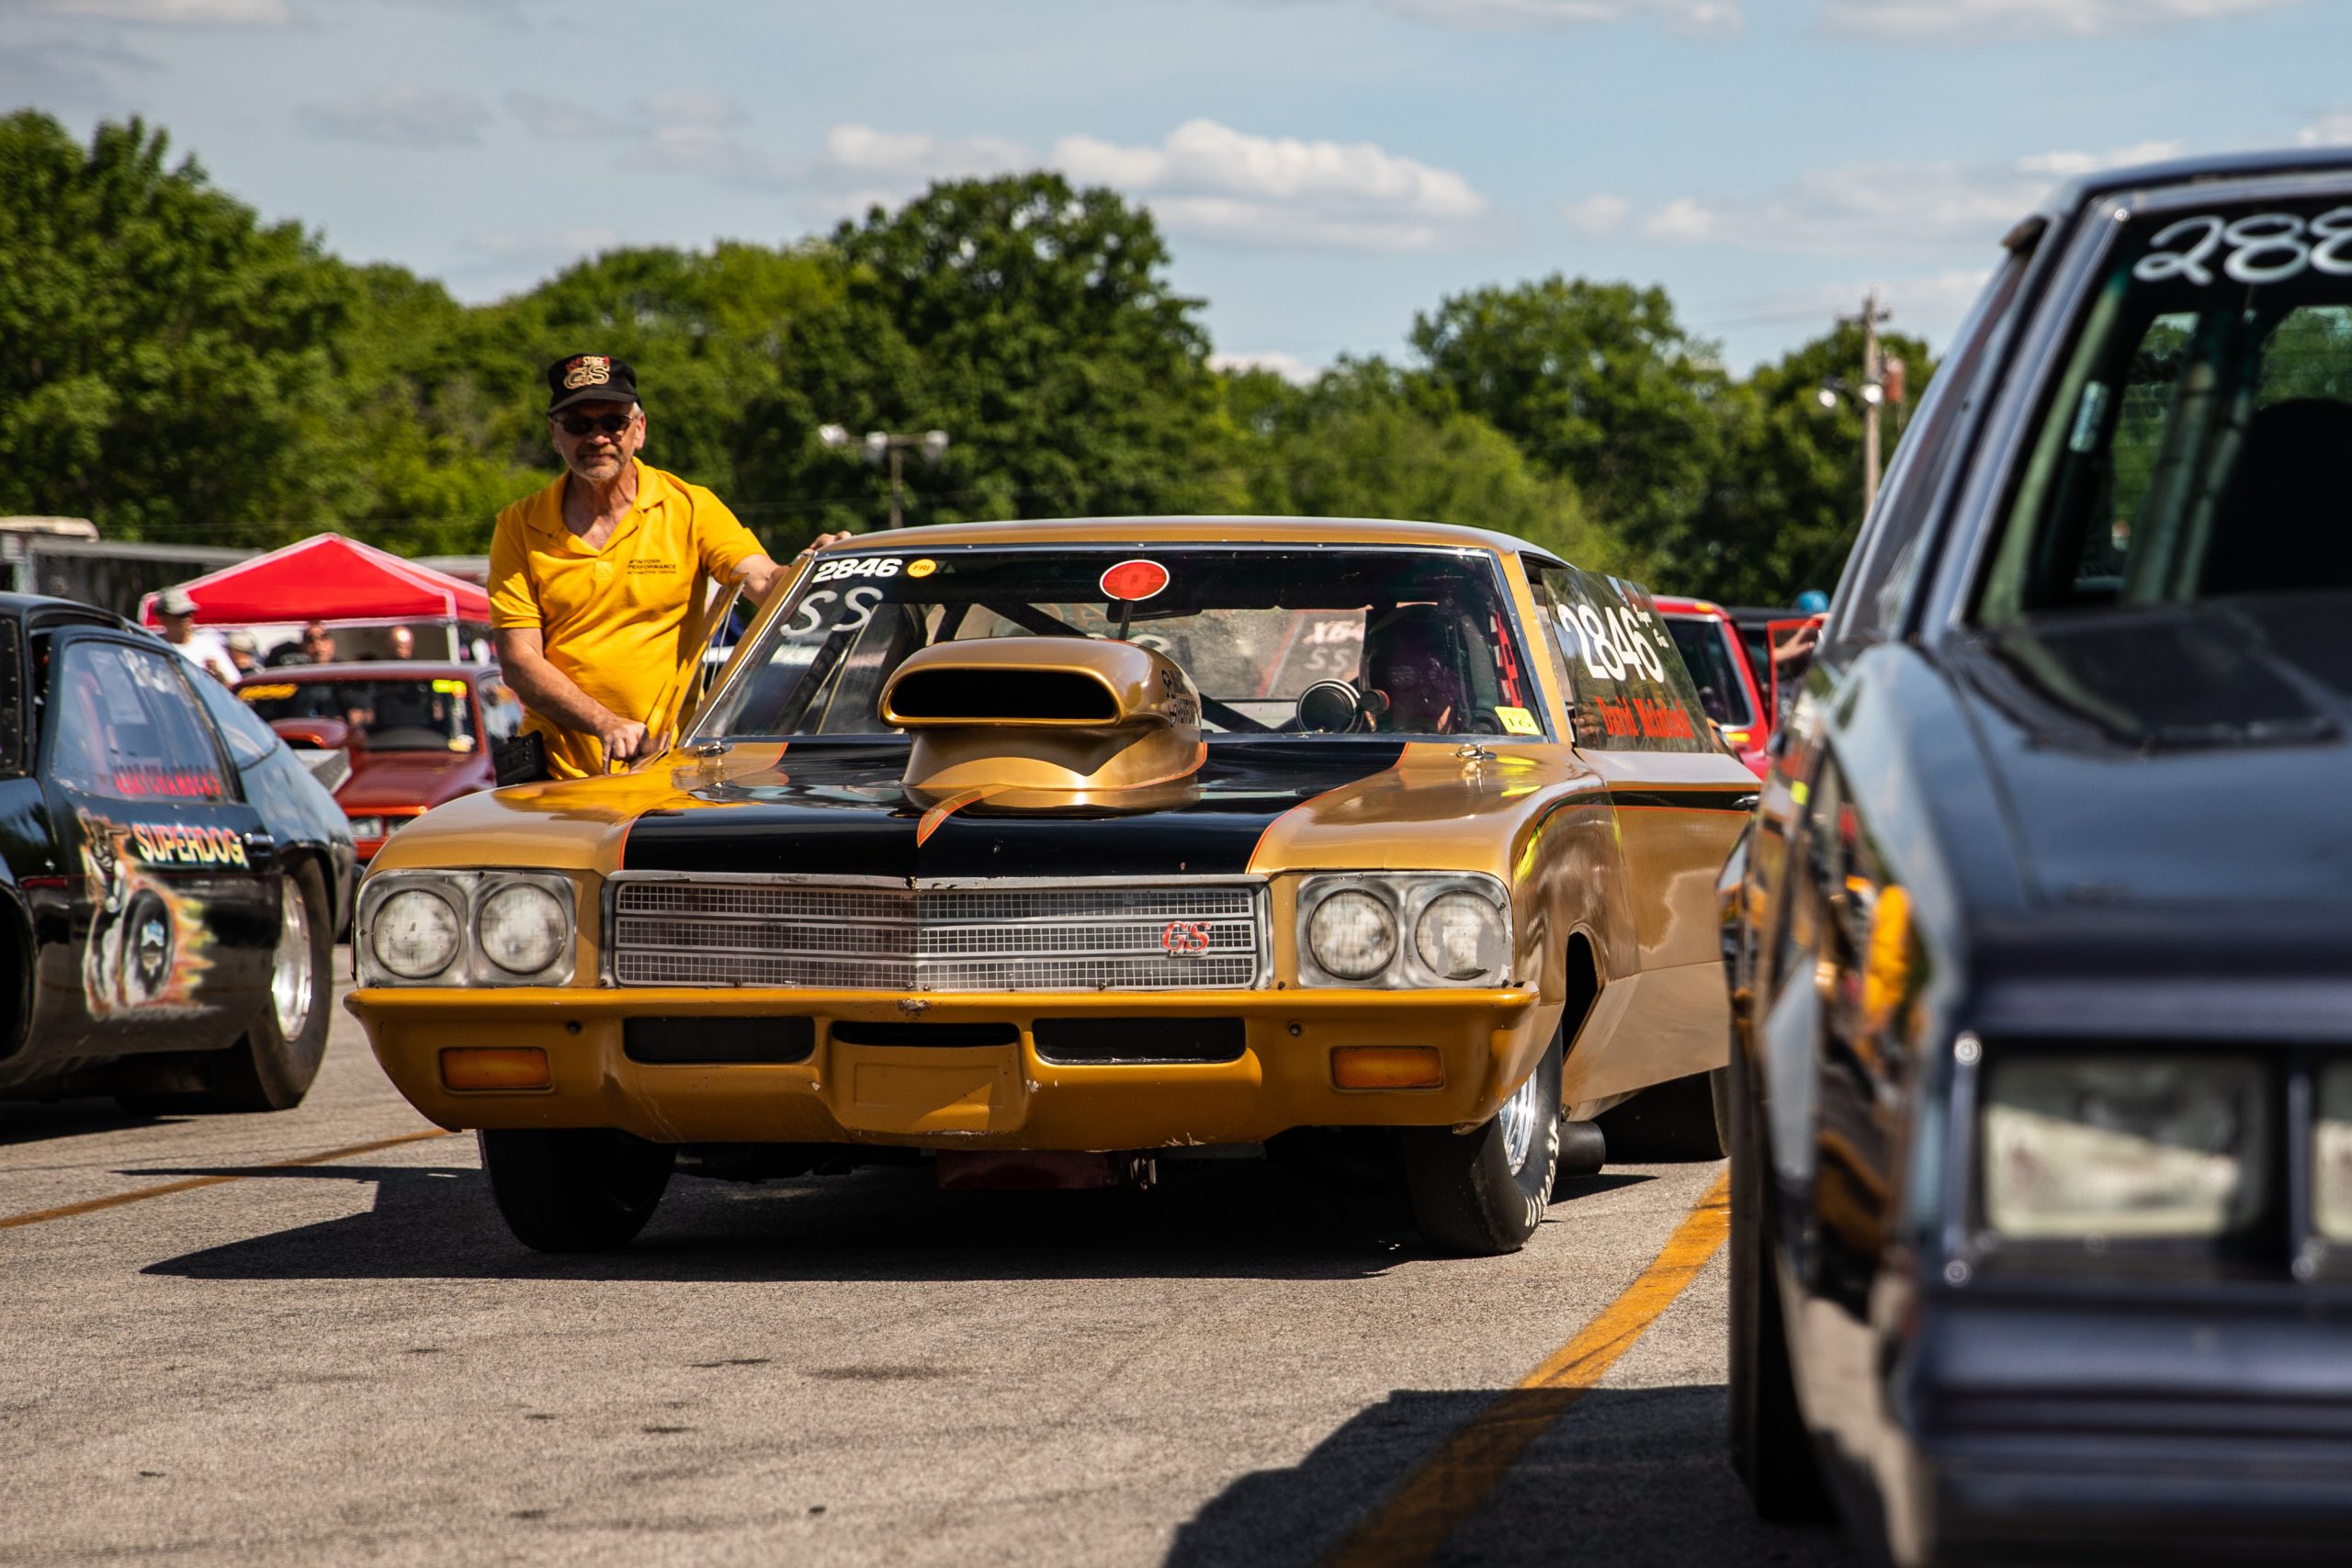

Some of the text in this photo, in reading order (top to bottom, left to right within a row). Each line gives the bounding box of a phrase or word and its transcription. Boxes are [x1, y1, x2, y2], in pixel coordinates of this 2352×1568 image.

[811, 558, 902, 583] 2846
[780, 586, 883, 637] SS
[1556, 604, 1665, 682] 2846
[131, 822, 250, 869] SUPERDOG
[1162, 920, 1212, 952] GS
